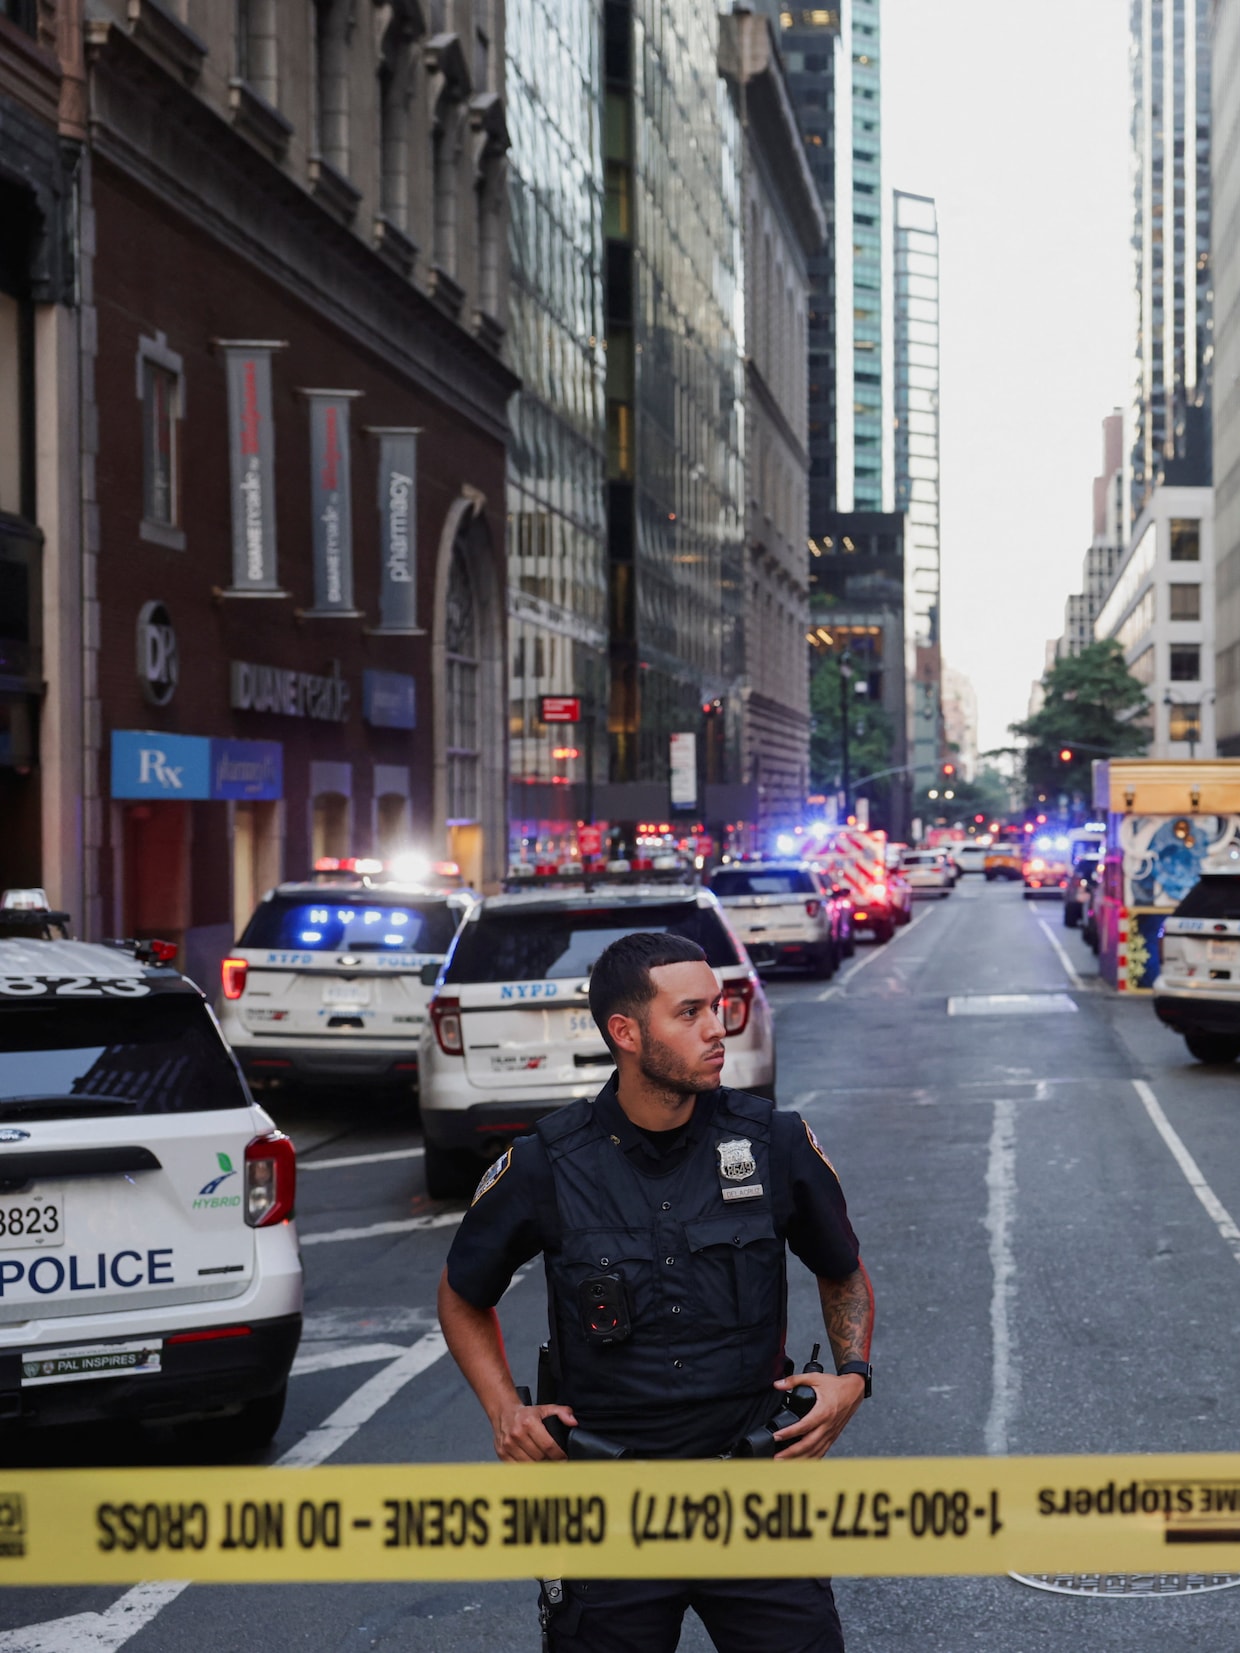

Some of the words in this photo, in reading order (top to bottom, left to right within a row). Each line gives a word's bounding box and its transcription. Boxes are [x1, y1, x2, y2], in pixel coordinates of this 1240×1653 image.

[388, 471, 413, 583] pharmacy
[138, 748, 184, 790] Rx
[310, 909, 409, 926] NYPD
[500, 983, 558, 999] NYPD
[727, 1162, 753, 1177] 8649
[192, 1195, 241, 1211] HYBRID
[0, 1248, 175, 1297] POLICE
[57, 1360, 79, 1371] PAL
[82, 1353, 137, 1369] INSPIRES
[96, 1501, 209, 1553] CROSS
[220, 1500, 285, 1550] NOT
[297, 1500, 341, 1549] DO
[384, 1497, 490, 1549] SCENE
[502, 1495, 606, 1547] CRIME
[630, 1489, 734, 1548] (8477)
[743, 1489, 1003, 1542] 1-800-577-TIPS
